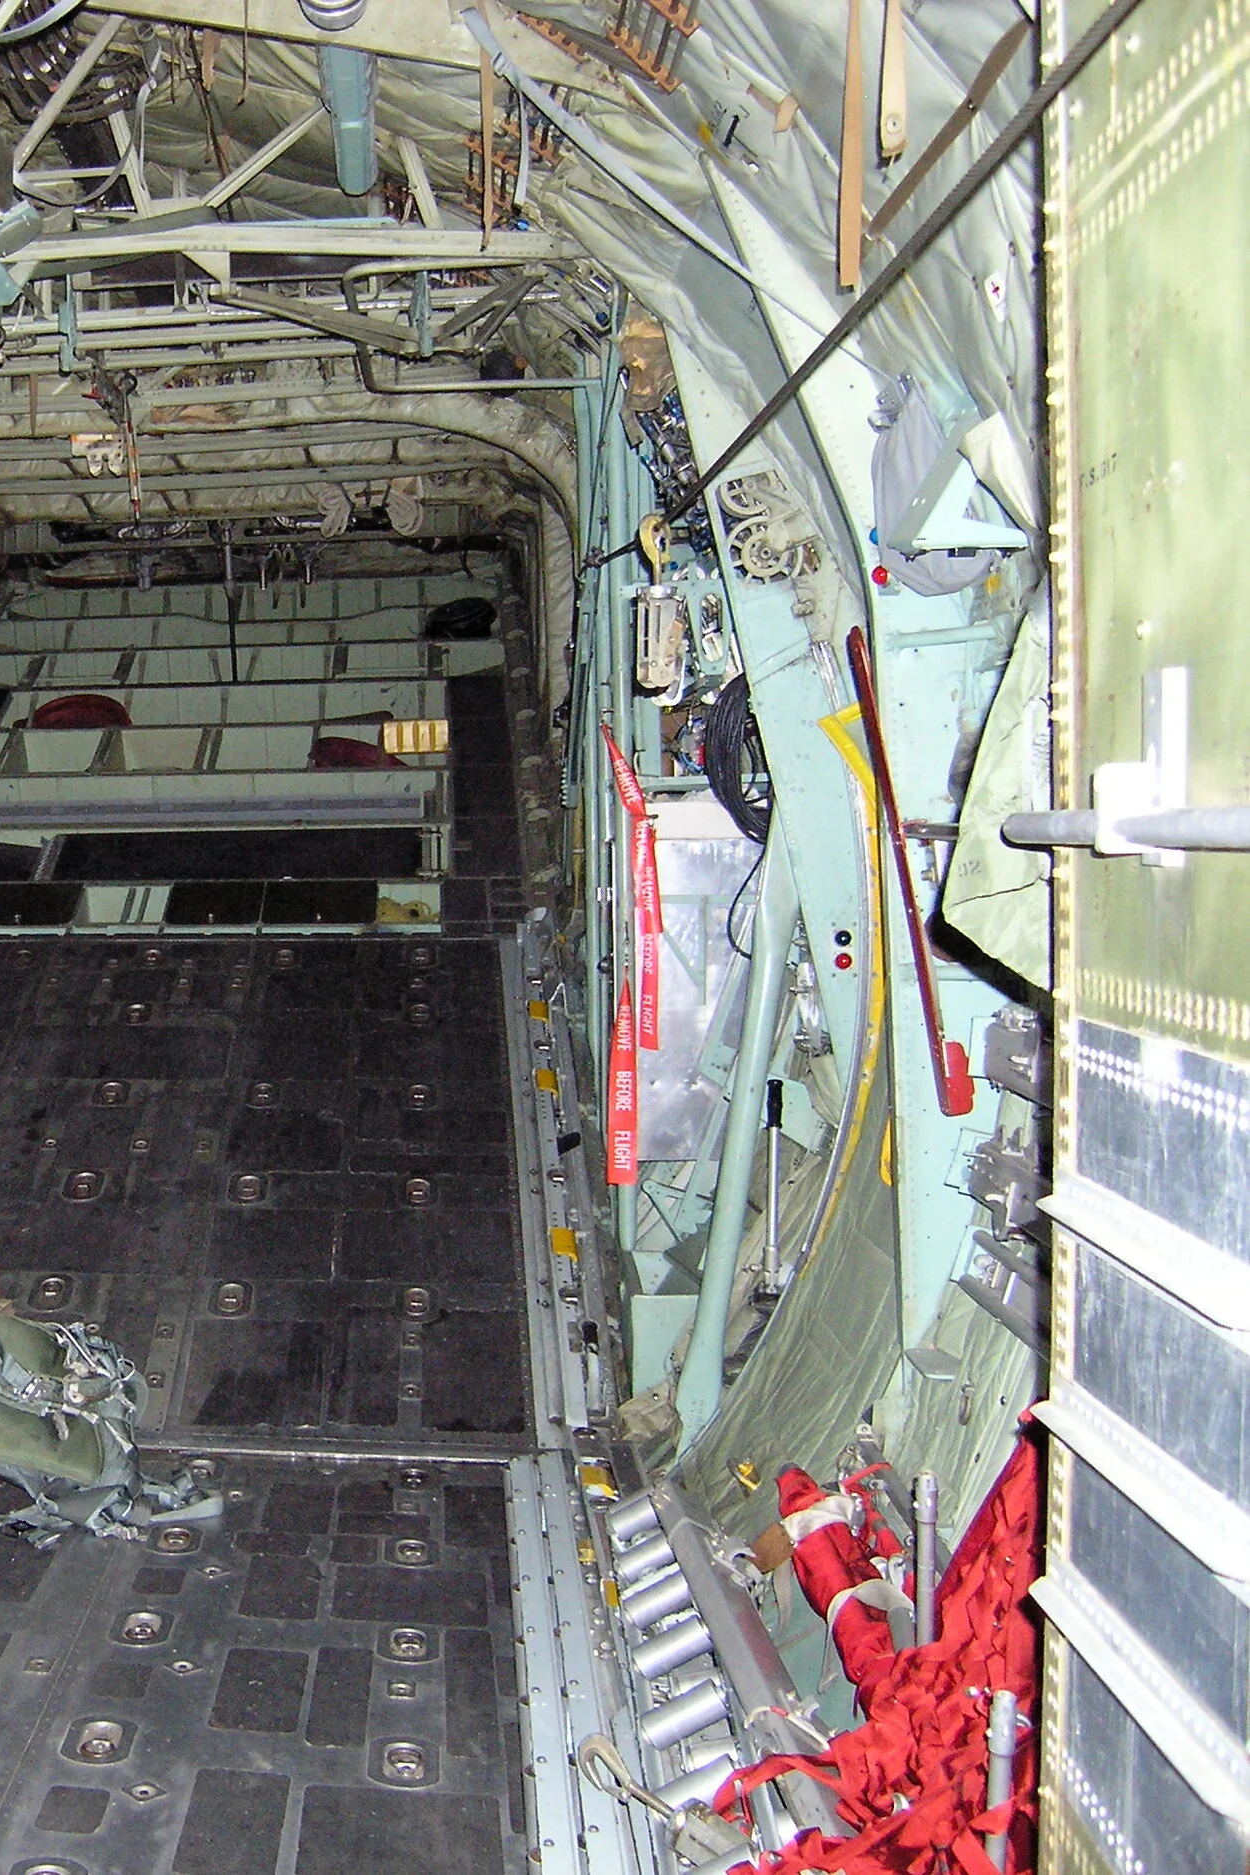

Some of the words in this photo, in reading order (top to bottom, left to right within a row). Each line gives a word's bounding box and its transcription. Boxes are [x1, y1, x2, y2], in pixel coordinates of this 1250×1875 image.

[613, 759, 642, 805] REMOVE
[617, 1005, 631, 1051] REMOVE
[642, 993, 654, 1036] FLIGHT
[615, 1070, 633, 1112] BEFORE
[614, 1130, 632, 1171] FLIGHT
